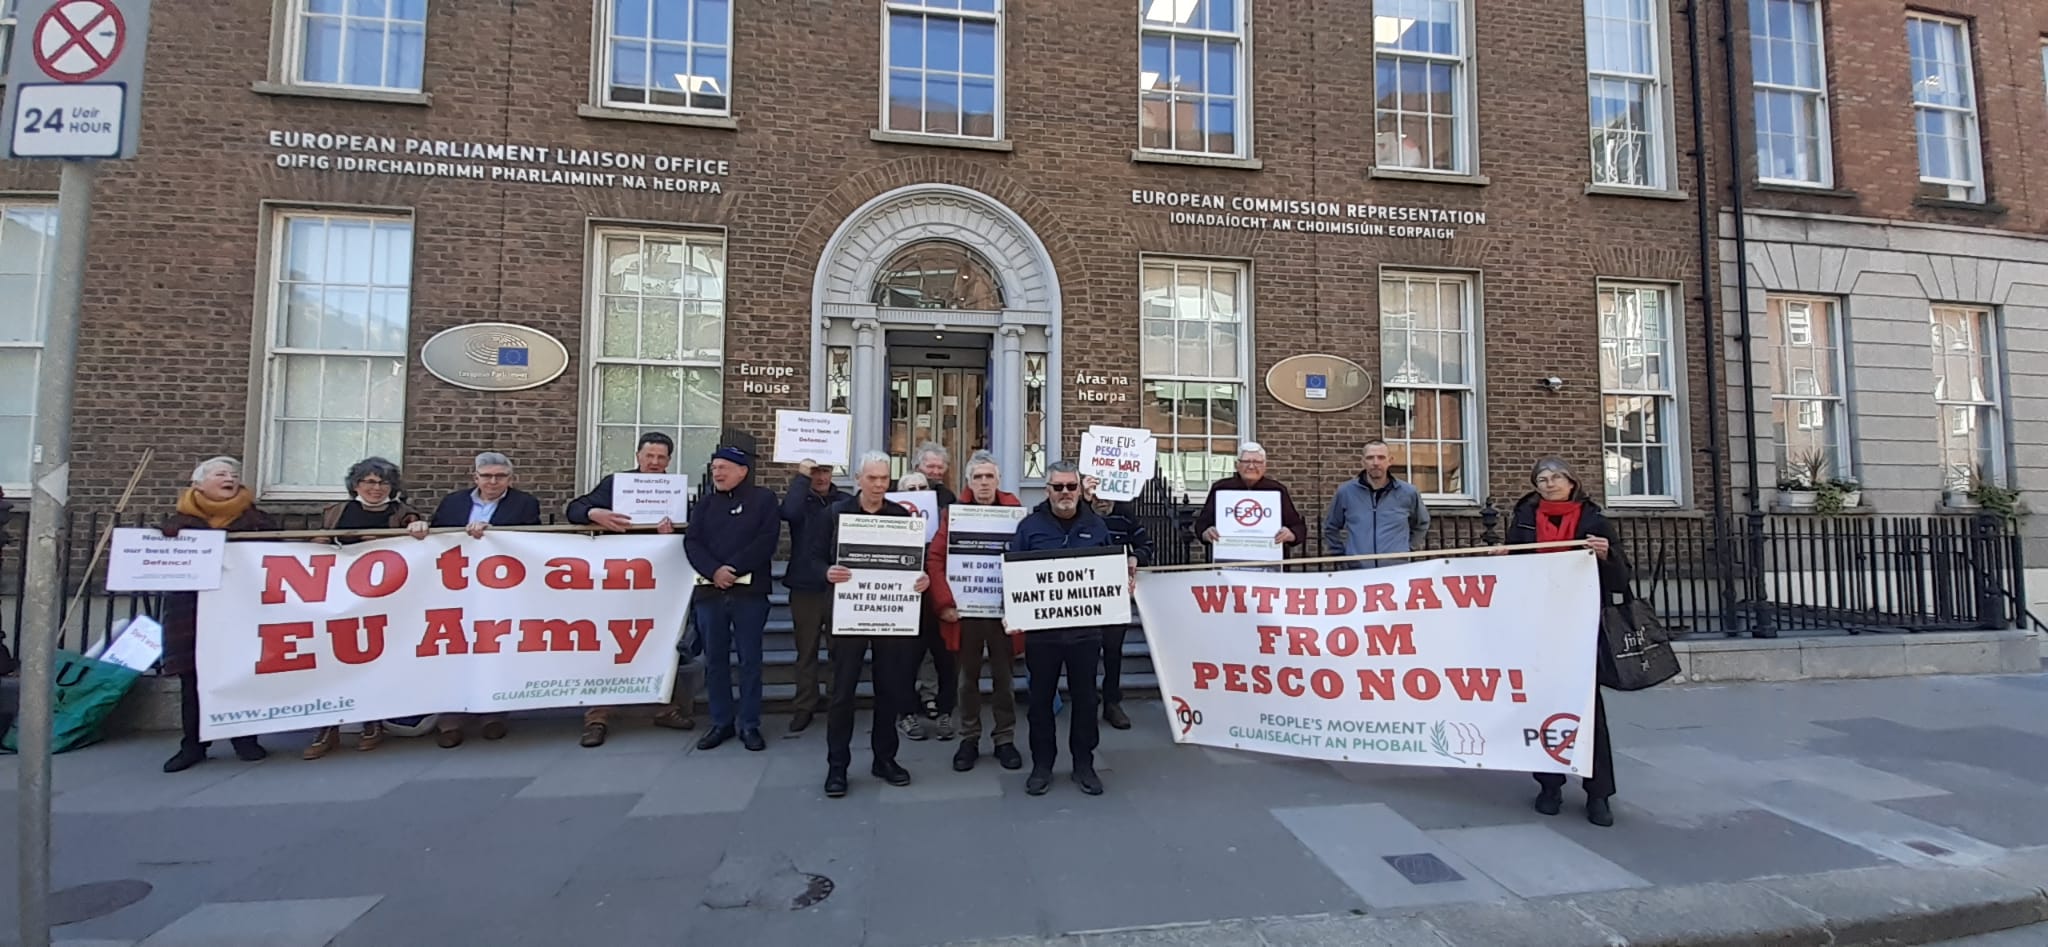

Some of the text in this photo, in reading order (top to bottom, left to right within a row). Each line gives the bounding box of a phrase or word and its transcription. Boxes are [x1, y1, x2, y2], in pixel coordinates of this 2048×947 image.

[23, 107, 64, 133] 24
[69, 122, 112, 133] HOUR
[269, 130, 730, 176] EUROPEAN PARLIAMENT LIAISON OFFICE
[276, 153, 722, 195] OIFIG IDIRCHAIDRIMH PHARLAIMINT NA hEORPA
[1132, 189, 1486, 225] EUROPEAN COMMISSION REPRESENTATION
[1170, 211, 1455, 239] IONADAÍOCHT AN CHOIMISIÚIN EORPAIGH
[740, 363, 794, 378] Europe
[1076, 370, 1128, 385] Áras na
[743, 381, 790, 393] House
[1078, 390, 1126, 403] hEorpa
[1100, 435, 1114, 445] THE
[1095, 445, 1122, 458] PESCO
[1091, 456, 1116, 468] MORE
[1096, 469, 1129, 479] WE NEED
[962, 561, 974, 569] WE
[261, 544, 656, 605] NO to an
[949, 575, 972, 583] WANT
[974, 575, 984, 583] EU
[1036, 567, 1095, 584] WE DON'T
[858, 582, 902, 591] WE DON'T
[963, 585, 1003, 594] EXPANSIO
[1011, 584, 1122, 604] WANT EU MILITARY
[866, 593, 877, 601] EU
[880, 594, 921, 602] MILITARY
[1191, 575, 1497, 616] WITHDRAW
[853, 604, 904, 613] EXPANSION
[1034, 603, 1102, 620] EXPANSION
[255, 607, 654, 675] EU Army
[1257, 624, 1417, 657] FROM
[525, 676, 653, 689] PEOPLE'S MOVEMENT
[1192, 661, 1527, 703] PESCO NOW!
[492, 685, 651, 701] GLUAISEACHT AN PHOBAIL
[209, 697, 355, 726] www.people.ie
[1260, 713, 1427, 736] PEOPLE'S MOVEMENT
[1229, 726, 1428, 753] GLUAISEACHT AN PHOBAIL
[1523, 728, 1576, 749] PES
